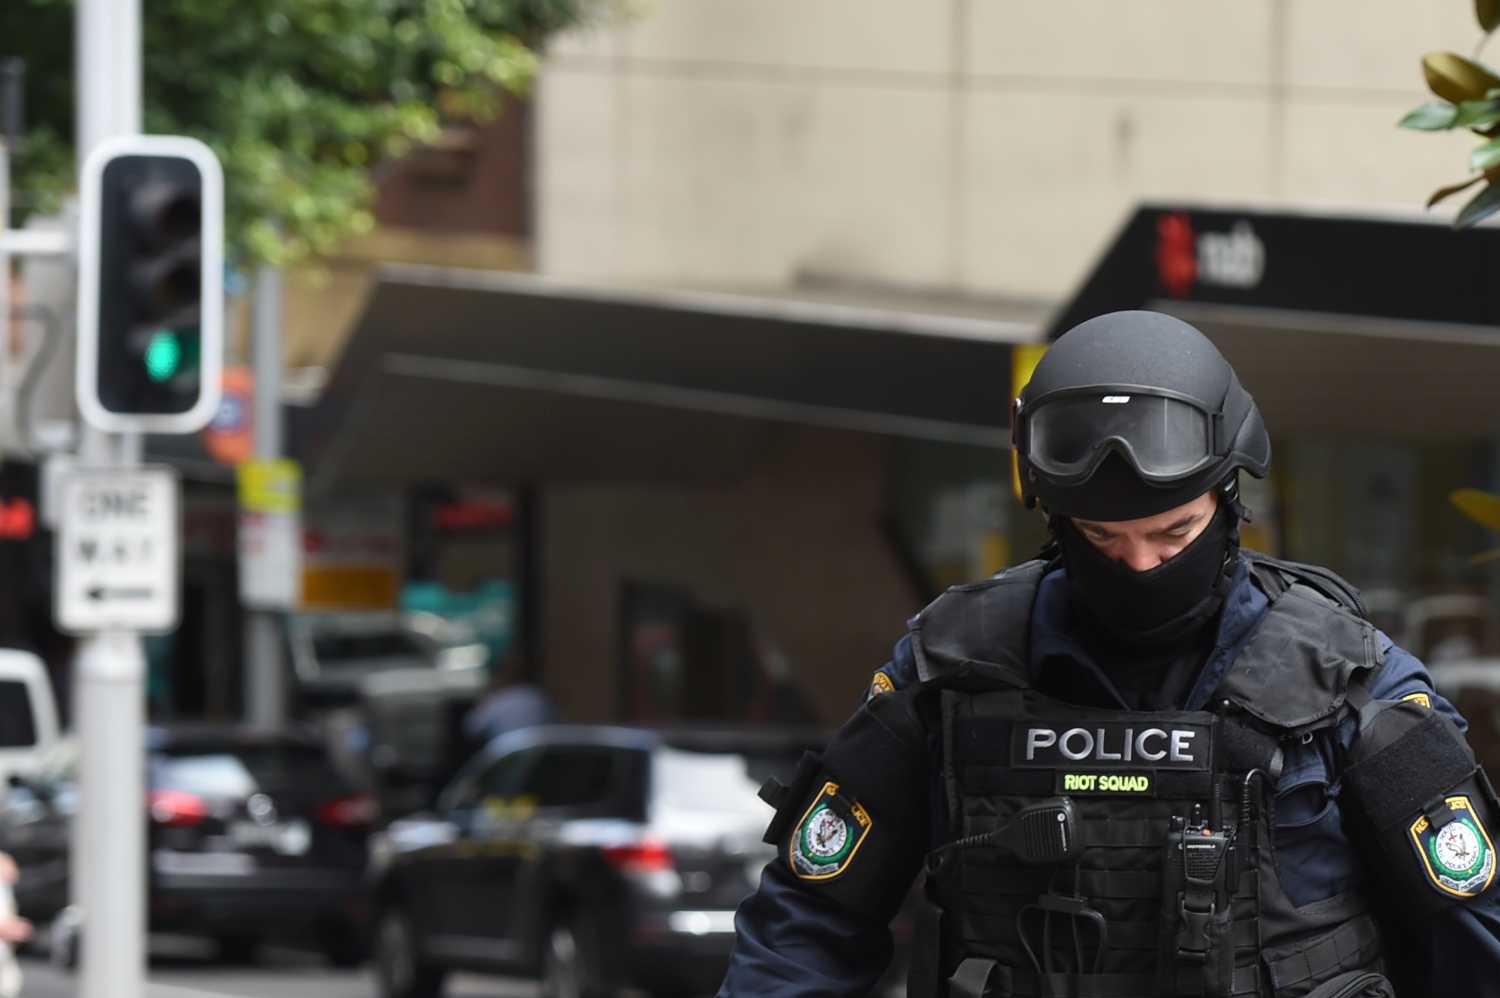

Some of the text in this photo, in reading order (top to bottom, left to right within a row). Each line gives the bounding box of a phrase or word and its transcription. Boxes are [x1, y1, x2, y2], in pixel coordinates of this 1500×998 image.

[1026, 728, 1196, 761] POLICE
[1064, 774, 1149, 791] RIOT SQUAD
